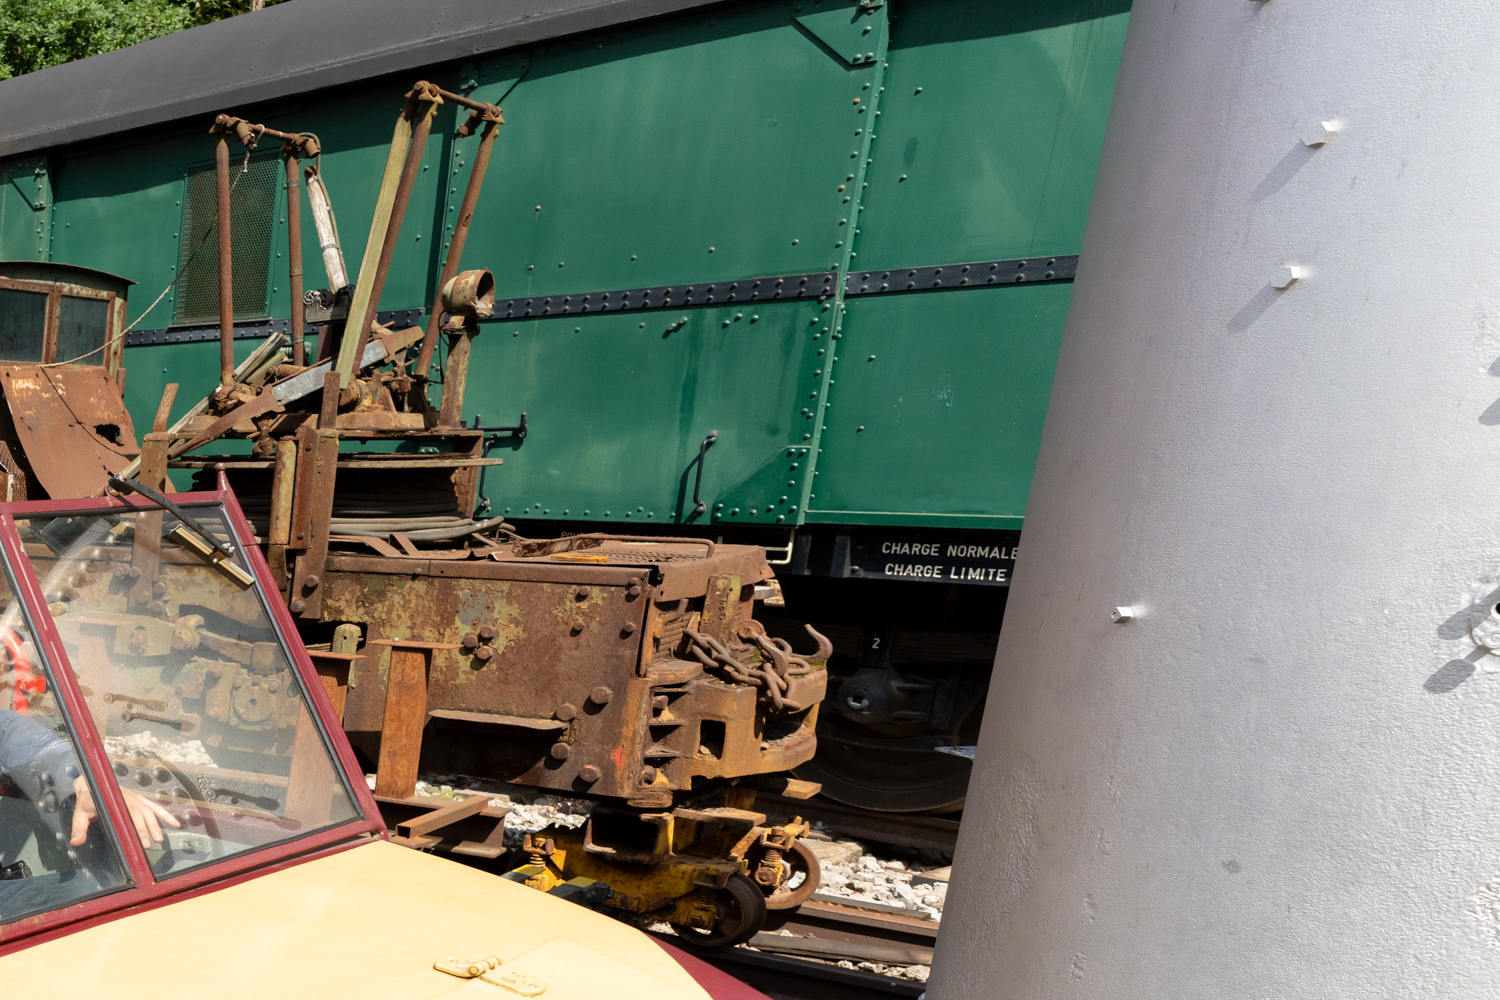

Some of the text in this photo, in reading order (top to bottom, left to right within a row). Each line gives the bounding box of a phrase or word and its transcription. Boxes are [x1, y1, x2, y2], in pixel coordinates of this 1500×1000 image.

[881, 541, 941, 557] CHARGE
[884, 563, 1008, 582] CHARGE LIMITE
[871, 637, 881, 649] 2
